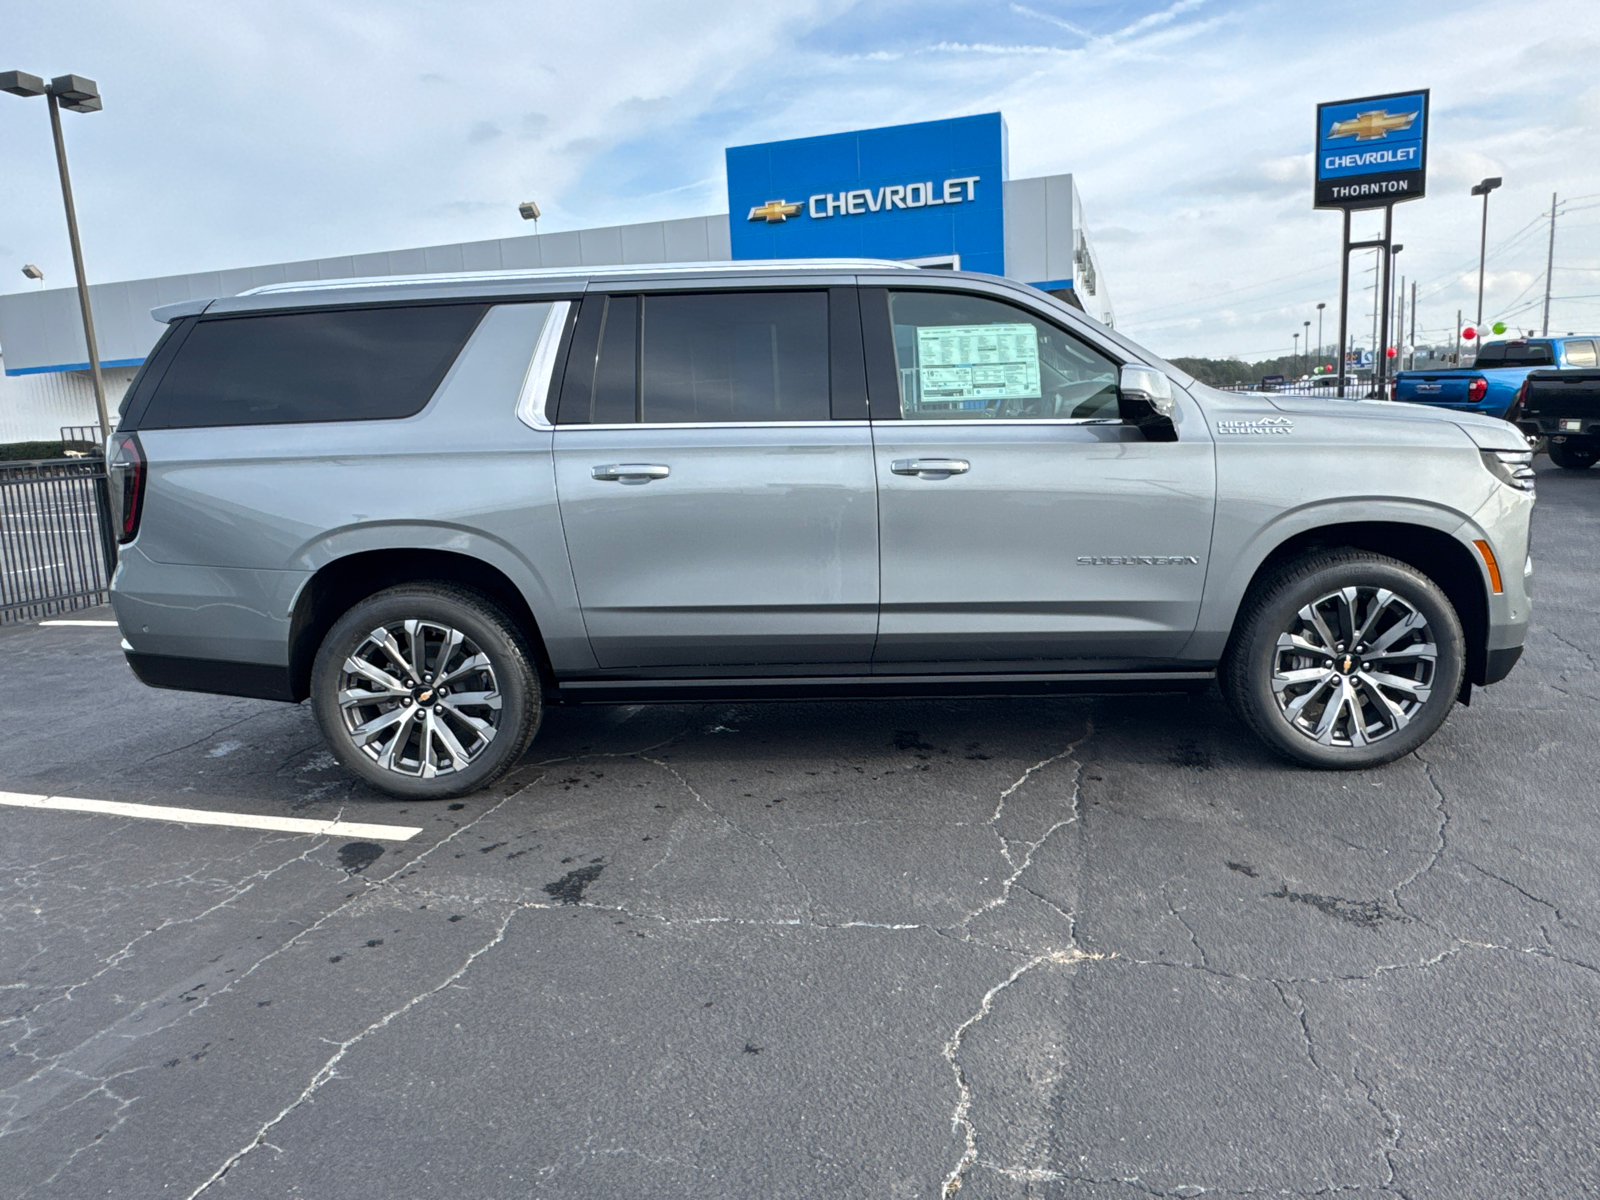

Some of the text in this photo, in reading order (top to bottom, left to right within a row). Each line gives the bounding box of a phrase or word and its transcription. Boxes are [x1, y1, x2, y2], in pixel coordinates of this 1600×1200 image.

[1325, 147, 1417, 169] CHEVROLET
[808, 176, 980, 219] CHEVROLET
[1332, 180, 1408, 198] THORNTON
[1218, 427, 1294, 435] COUNTRY
[1076, 555, 1200, 566] SUBURBAN
